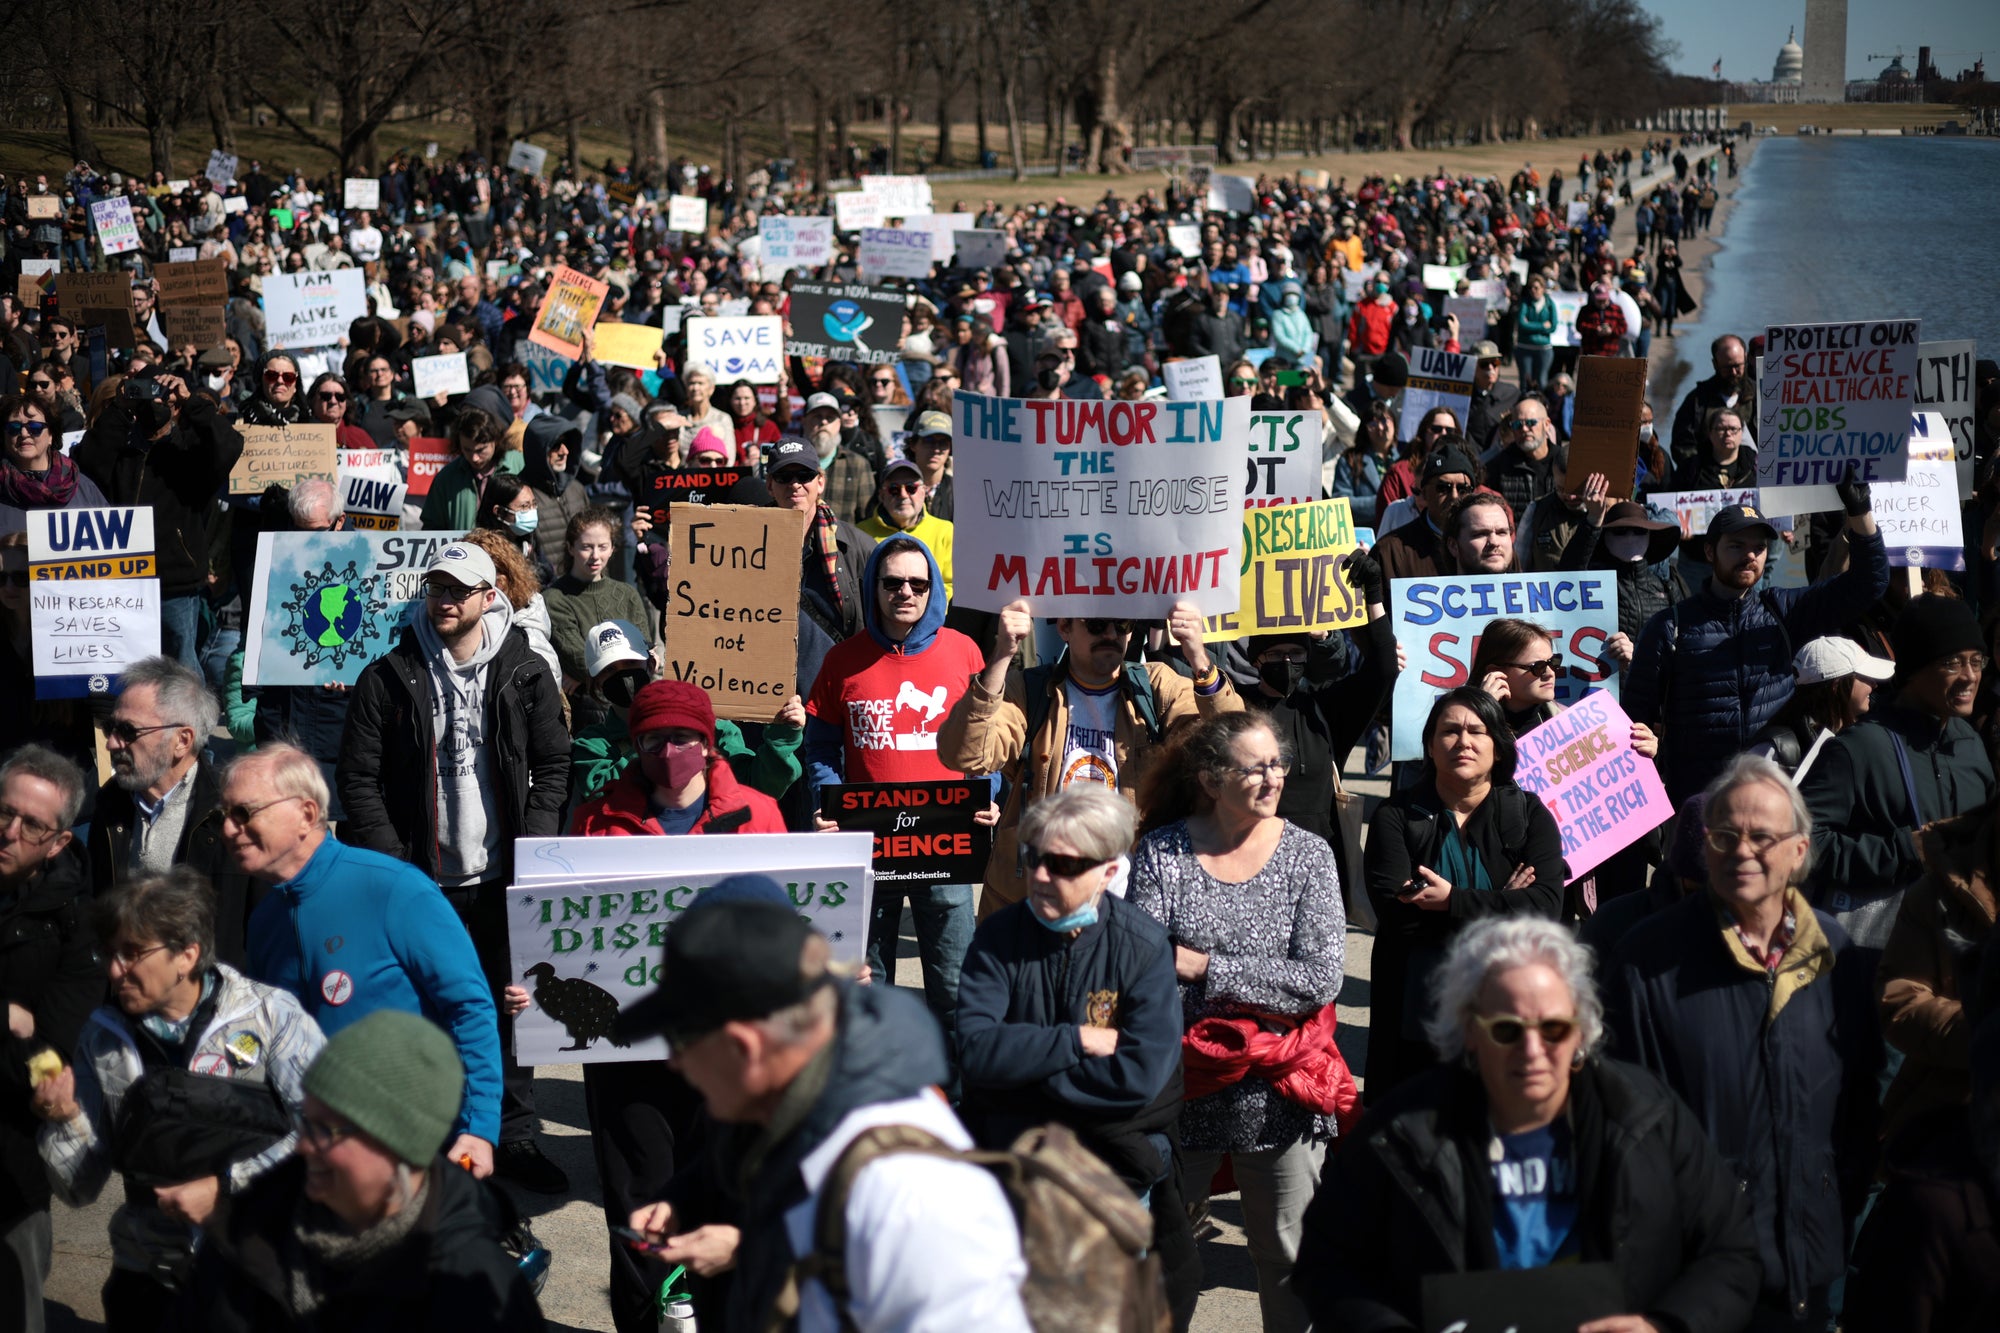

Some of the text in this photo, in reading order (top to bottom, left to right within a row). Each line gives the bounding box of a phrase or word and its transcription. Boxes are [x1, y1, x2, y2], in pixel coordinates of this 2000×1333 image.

[863, 228, 932, 248] SCIENCE
[66, 274, 117, 288] PROTECT
[293, 273, 331, 288] I AM
[562, 269, 593, 291] SCIENCE
[290, 305, 338, 325] ALIVE
[320, 321, 350, 337] SCIEN
[704, 327, 771, 347] SAVE
[1767, 322, 1917, 351] PROTECT OUR
[785, 341, 902, 366] SCIENCE NOT SILENCE
[1421, 350, 1467, 378] UAW
[1783, 349, 1896, 378] SCIENCE
[1410, 380, 1469, 393] STAND UP
[1781, 375, 1909, 404] HEALTHCARE
[1914, 352, 1970, 403] LTH
[956, 394, 1224, 446] THE TUMOR IN
[1778, 406, 1847, 432] JOBS
[283, 429, 324, 443] BUILDS
[1248, 414, 1304, 452] CTS
[1778, 431, 1904, 458] EDUCATION
[282, 444, 326, 457] ACROSS
[347, 453, 361, 467] NO
[364, 452, 383, 467] CURE
[1053, 450, 1115, 476] THE
[248, 459, 318, 473] CULTURES
[1776, 457, 1881, 485] FUTURE
[230, 477, 242, 491] I
[654, 473, 739, 490] STAND UP
[347, 478, 397, 511] UAW
[688, 490, 705, 503] for
[983, 475, 1229, 519] WHITE HOUSE
[1874, 495, 1935, 513] ANCER
[47, 509, 134, 551] UAW
[352, 516, 396, 530] AND UP
[1254, 503, 1350, 556] RESEARCH
[1876, 519, 1949, 535] ESEARCH
[376, 538, 461, 571] STA
[689, 522, 768, 570] Fund
[1063, 531, 1114, 556] IS
[36, 559, 149, 581] STAND UP
[987, 547, 1229, 597] MALIGNANT
[396, 573, 427, 600] SCIE
[1255, 553, 1363, 629] LIVES!
[33, 595, 144, 610] NIH RESEARCH
[676, 580, 782, 623] Science
[1403, 580, 1604, 625] SCIENCE
[53, 616, 121, 632] SAVES
[54, 643, 114, 659] LIVES
[714, 633, 745, 651] not
[671, 660, 784, 696] Violence
[847, 699, 894, 716] PEACE
[849, 714, 894, 732] LOVE
[1532, 701, 1609, 758] DOLLARS
[852, 730, 896, 750] DATA
[1066, 724, 1116, 757] ASHINGT
[1545, 724, 1617, 786] SCIENCE
[1560, 775, 1600, 815] TAX
[1596, 749, 1636, 789] CUTS
[842, 787, 971, 810] STAND UP
[892, 811, 921, 832] for
[1561, 824, 1582, 857] OR
[1574, 805, 1612, 842] THE
[1604, 779, 1649, 825] RICH
[870, 833, 972, 859] CIENCE
[912, 870, 951, 880] Scientists
[324, 978, 348, 996] TRUMP
